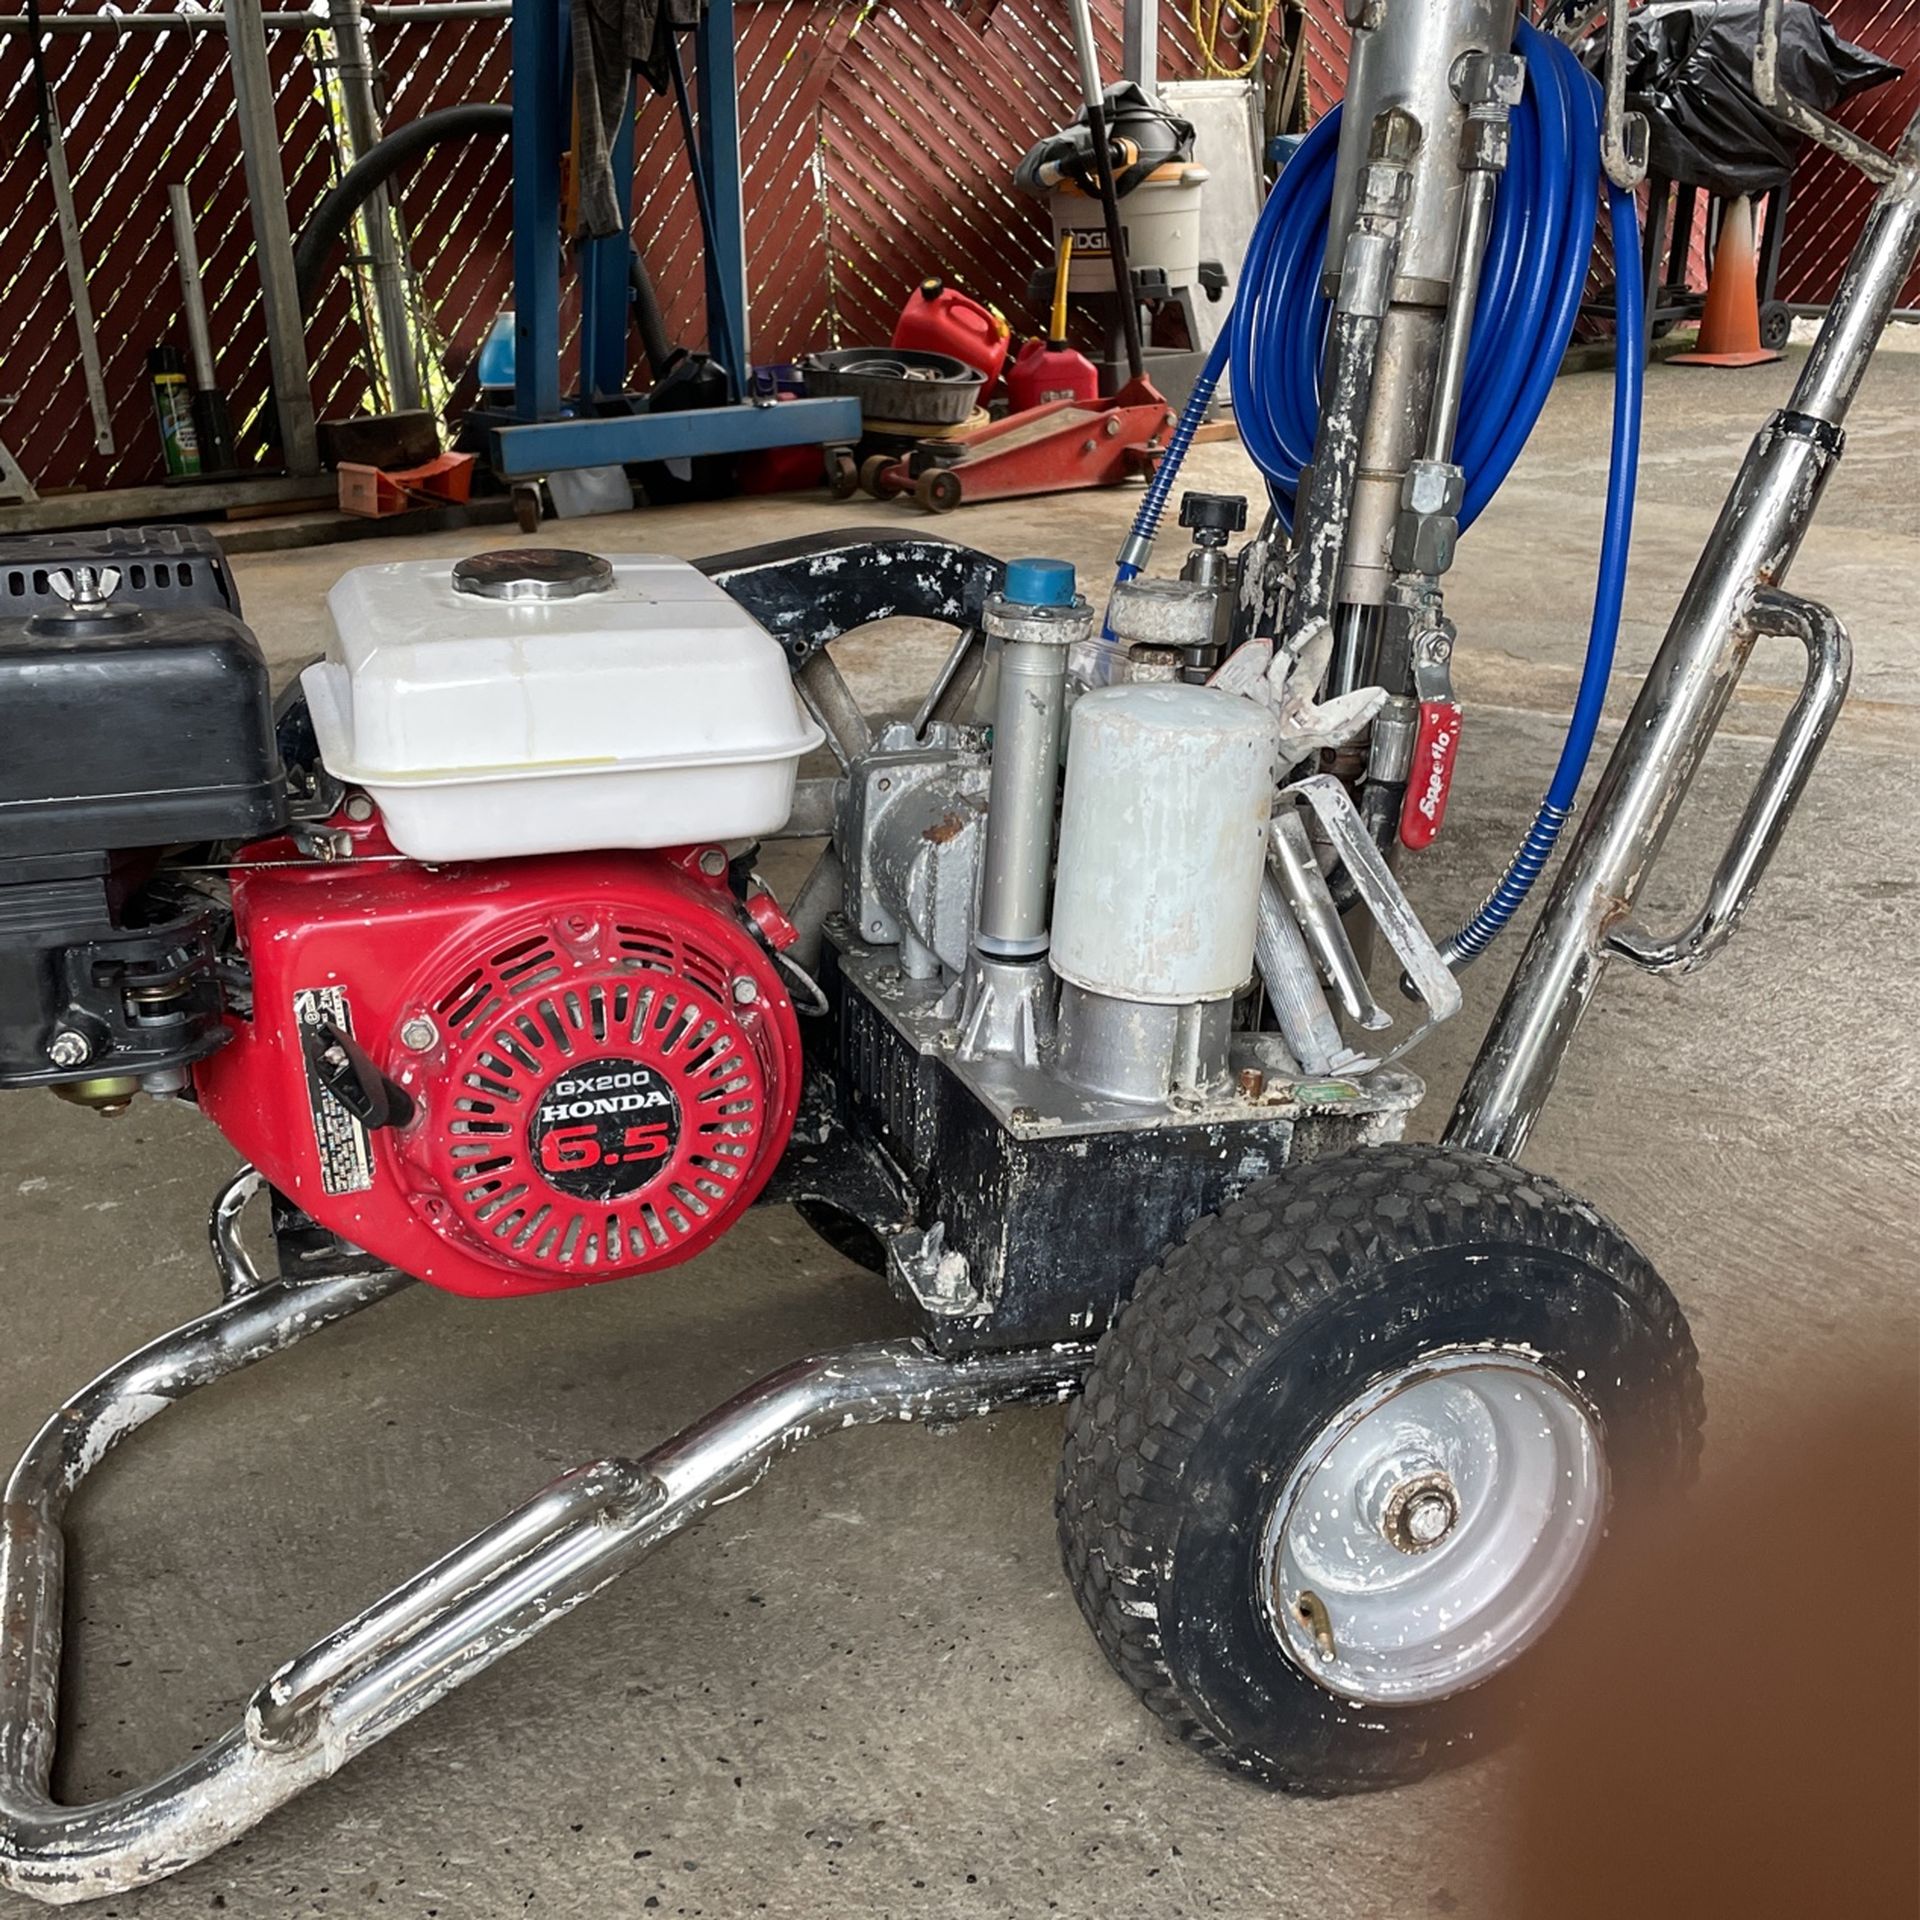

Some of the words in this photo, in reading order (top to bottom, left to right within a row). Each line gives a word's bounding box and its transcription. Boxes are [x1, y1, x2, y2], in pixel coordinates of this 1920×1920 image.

[556, 1070, 650, 1097] GX200
[541, 1090, 671, 1122] HONDA
[540, 1122, 669, 1172] 6.5
